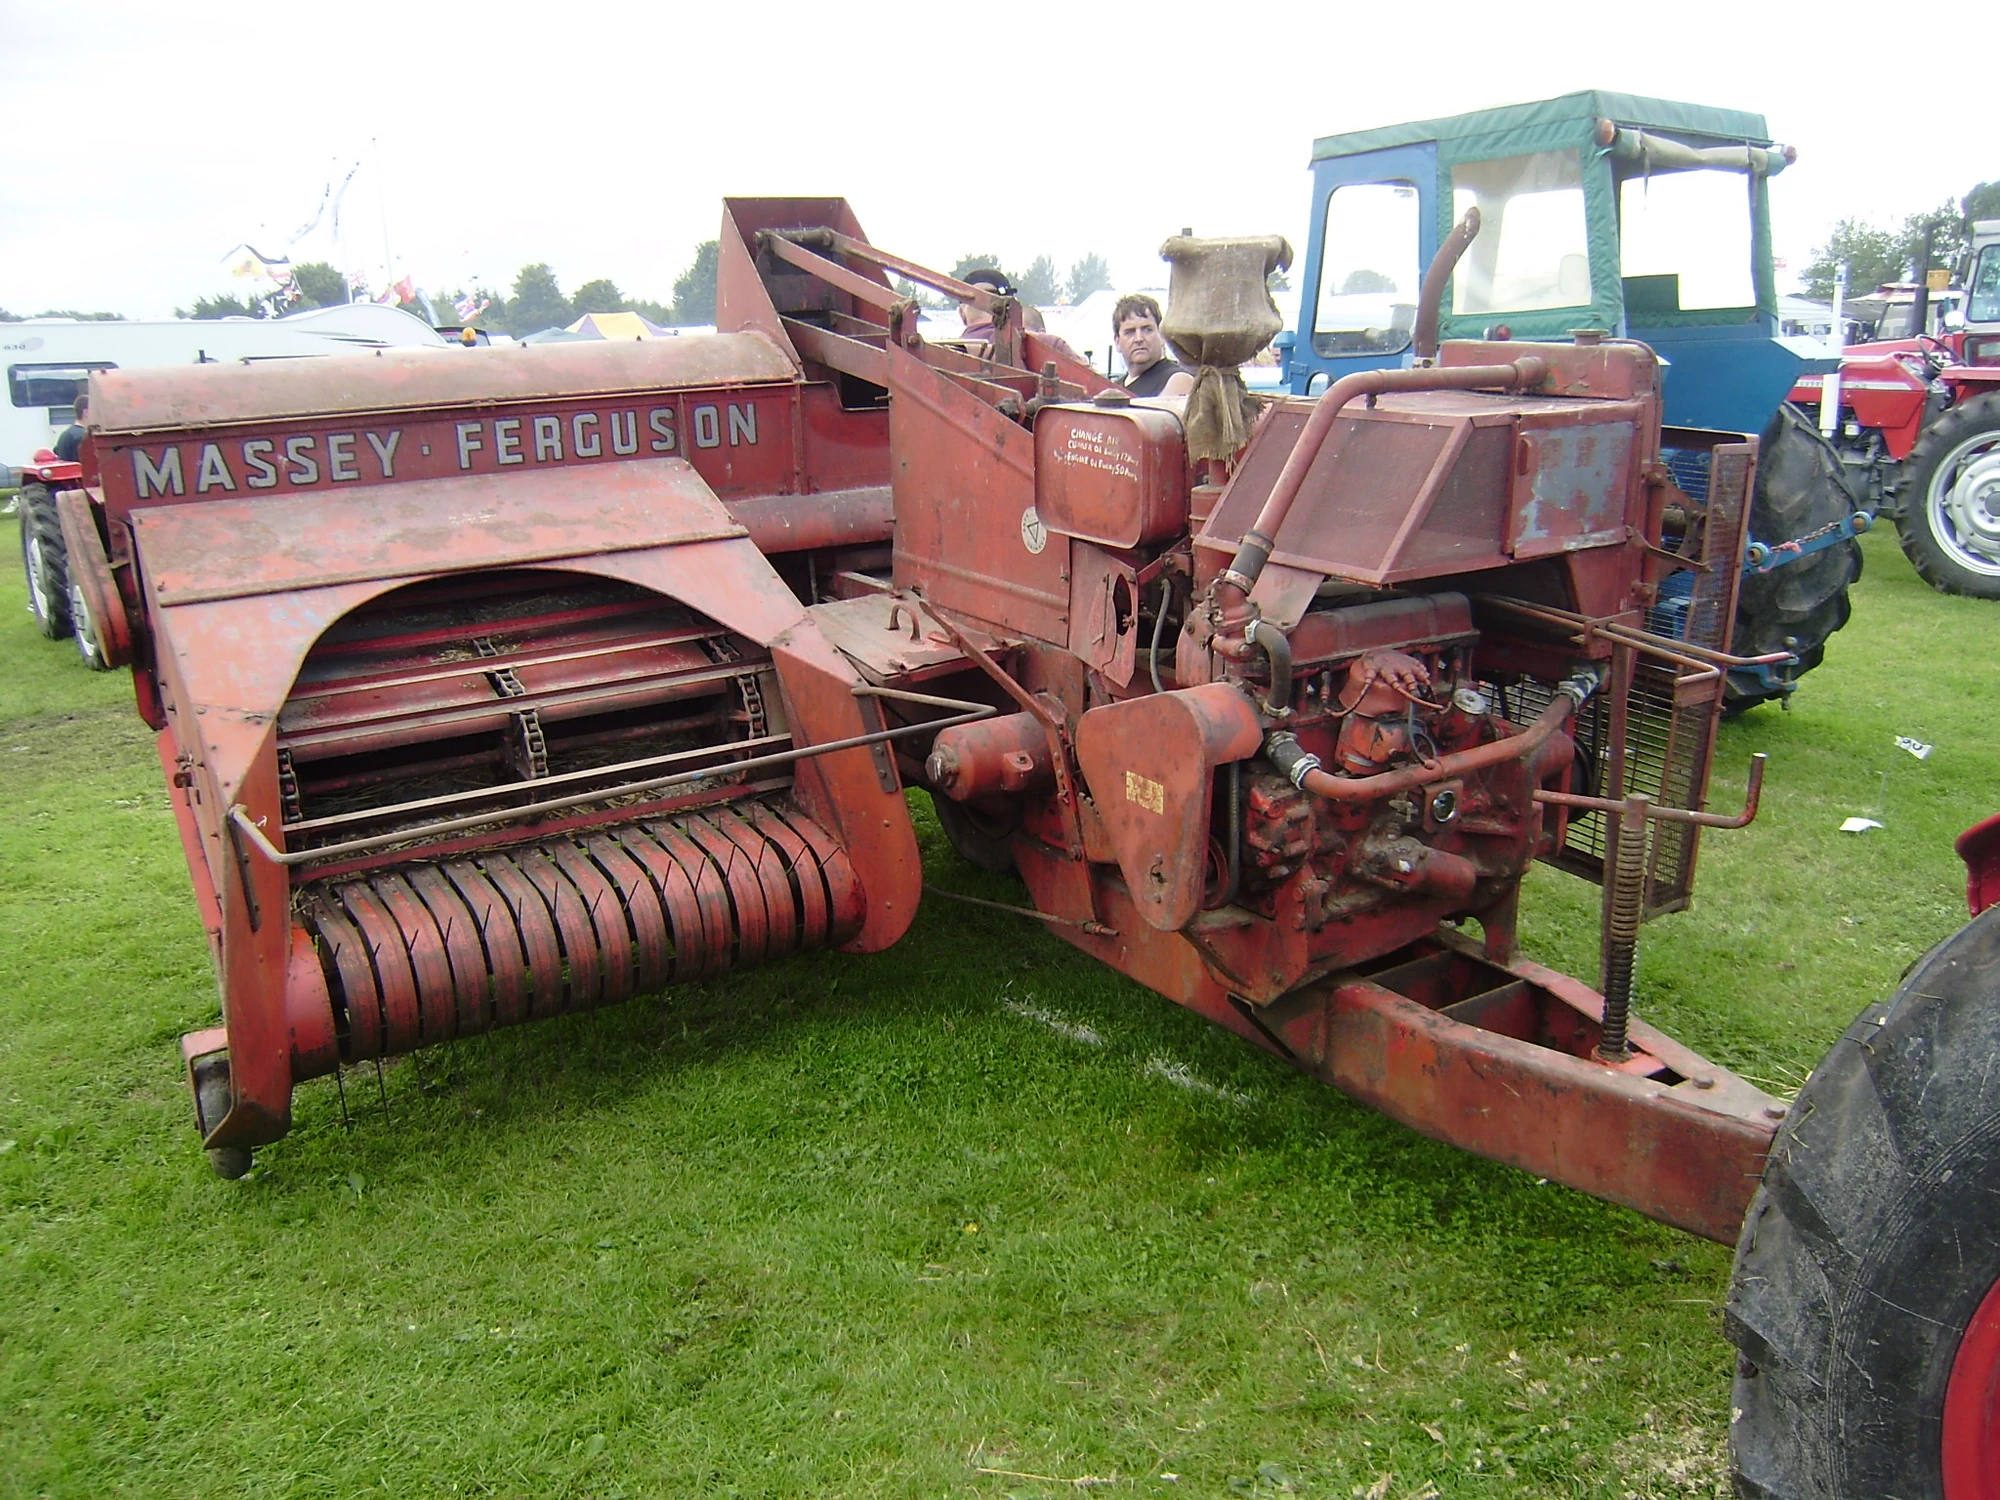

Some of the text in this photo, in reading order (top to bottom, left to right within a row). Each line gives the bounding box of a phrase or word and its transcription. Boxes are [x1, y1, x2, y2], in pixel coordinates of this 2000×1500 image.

[131, 403, 758, 499] MASSEY FERGUSON
[1071, 428, 1103, 443] CHANGE
